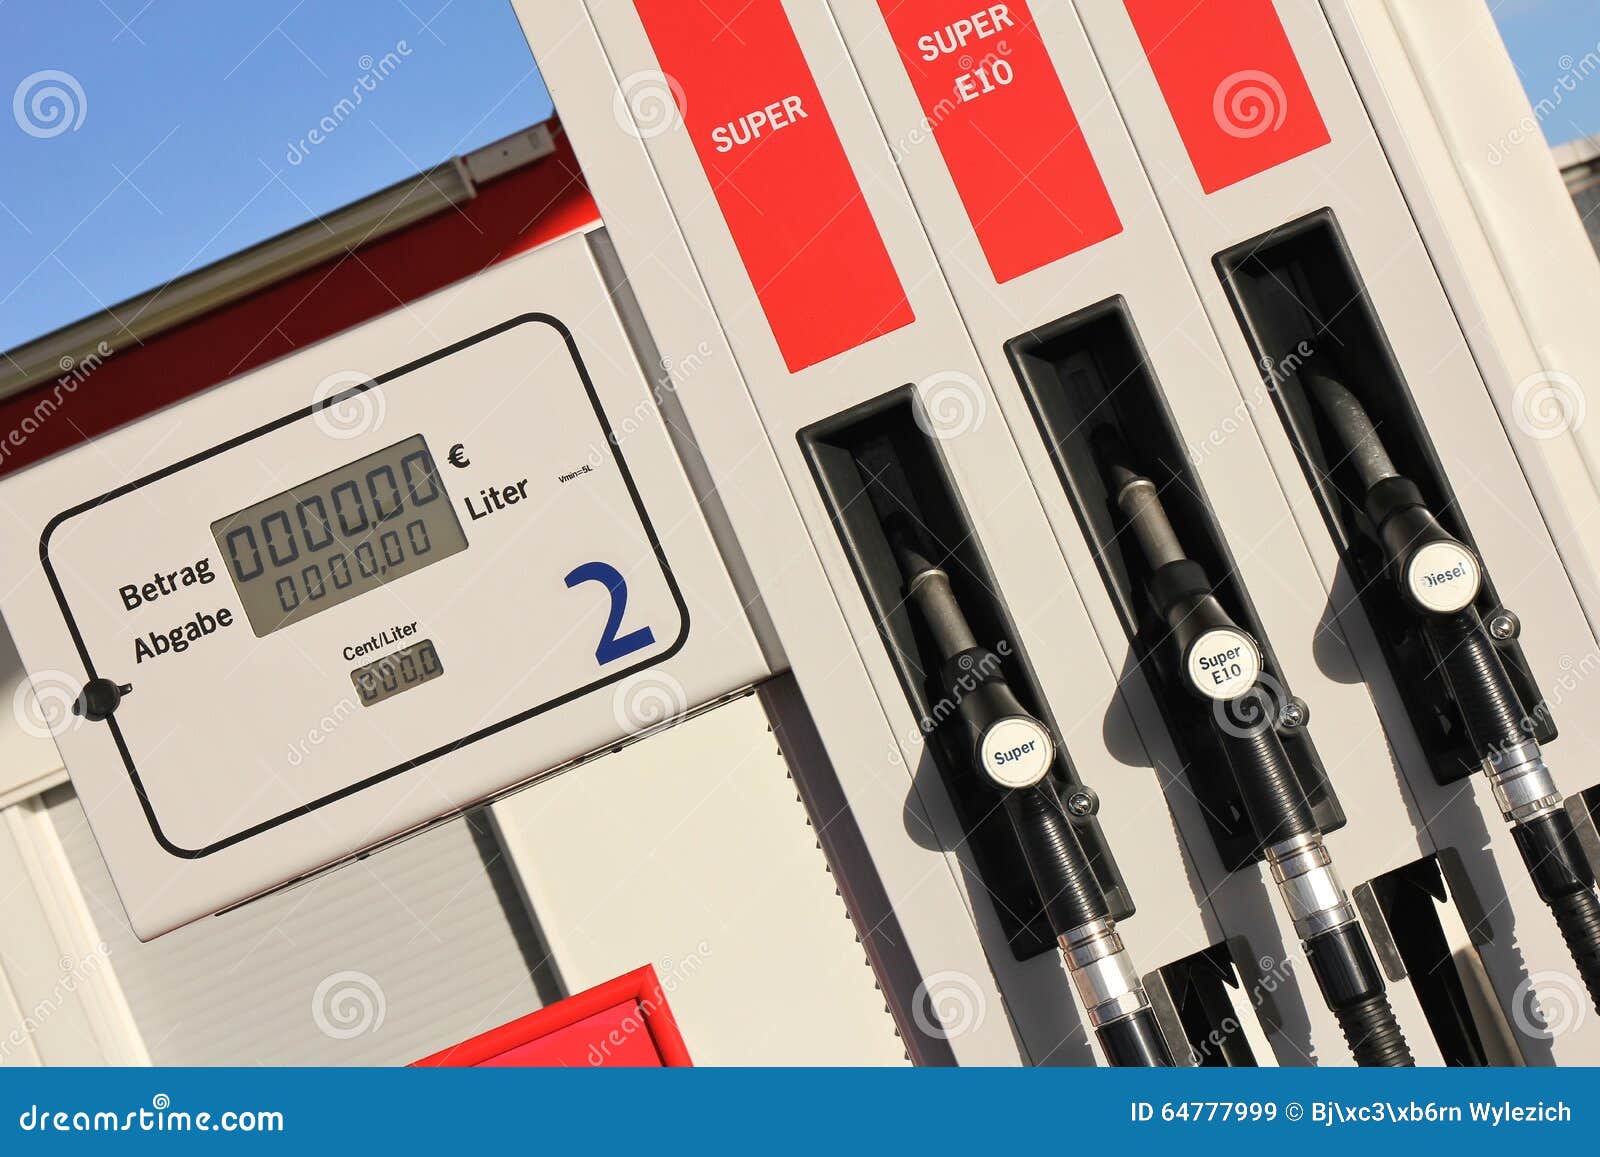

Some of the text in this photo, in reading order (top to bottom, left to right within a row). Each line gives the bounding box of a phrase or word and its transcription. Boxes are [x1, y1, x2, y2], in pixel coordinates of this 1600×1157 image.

[917, 3, 1015, 62] SUPER
[954, 58, 1014, 103] E10
[711, 95, 808, 153] SUPER
[447, 443, 471, 469] €
[464, 478, 528, 521] Liter
[118, 557, 216, 611] Betrag
[133, 607, 234, 664] Abgabe
[564, 561, 656, 666] 2
[342, 621, 418, 661] Cent/Liter
[1198, 644, 1242, 672] Super
[1211, 664, 1242, 686] E10
[994, 738, 1037, 767] Super
